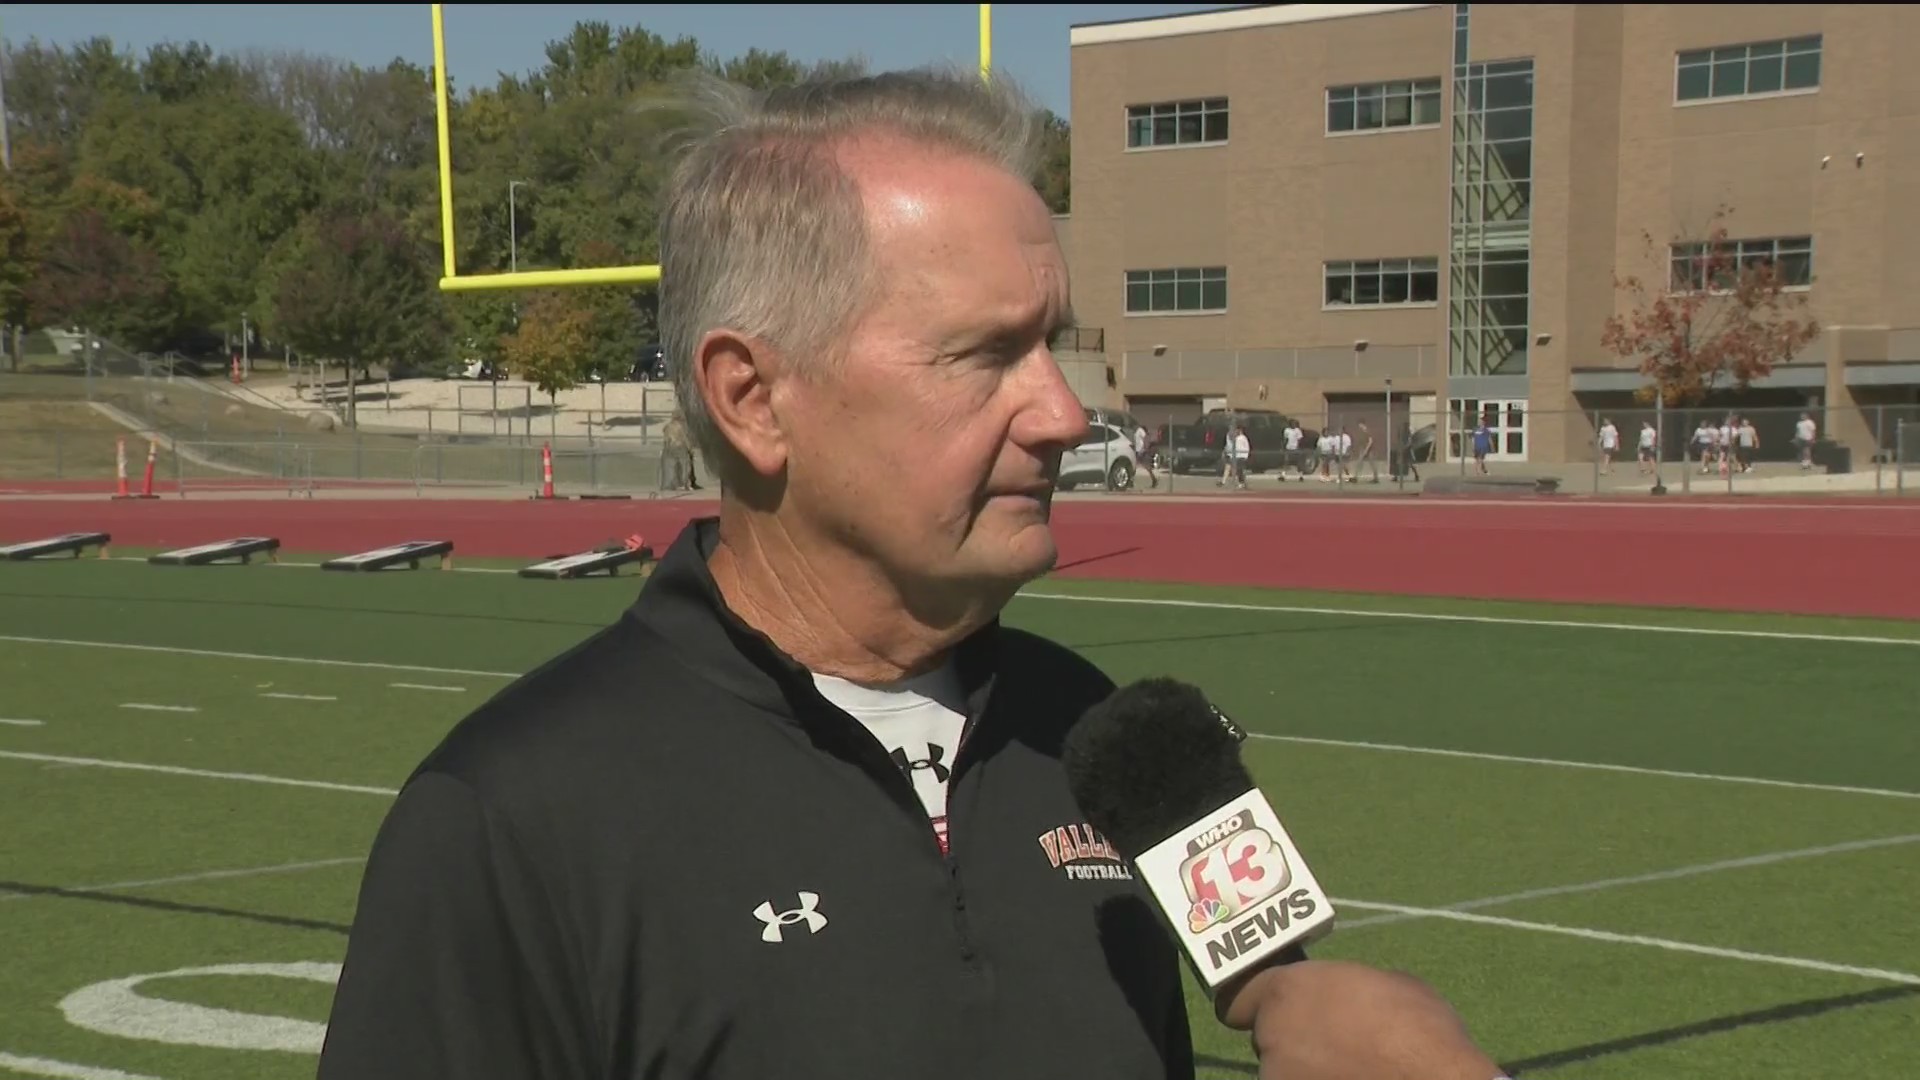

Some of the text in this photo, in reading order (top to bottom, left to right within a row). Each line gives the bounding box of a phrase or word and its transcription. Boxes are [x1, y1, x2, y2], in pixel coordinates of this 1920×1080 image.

[1194, 815, 1243, 849] WHO
[1065, 865, 1133, 880] FOOTBALL
[1199, 828, 1283, 908] 13
[1205, 888, 1316, 970] NEWS
